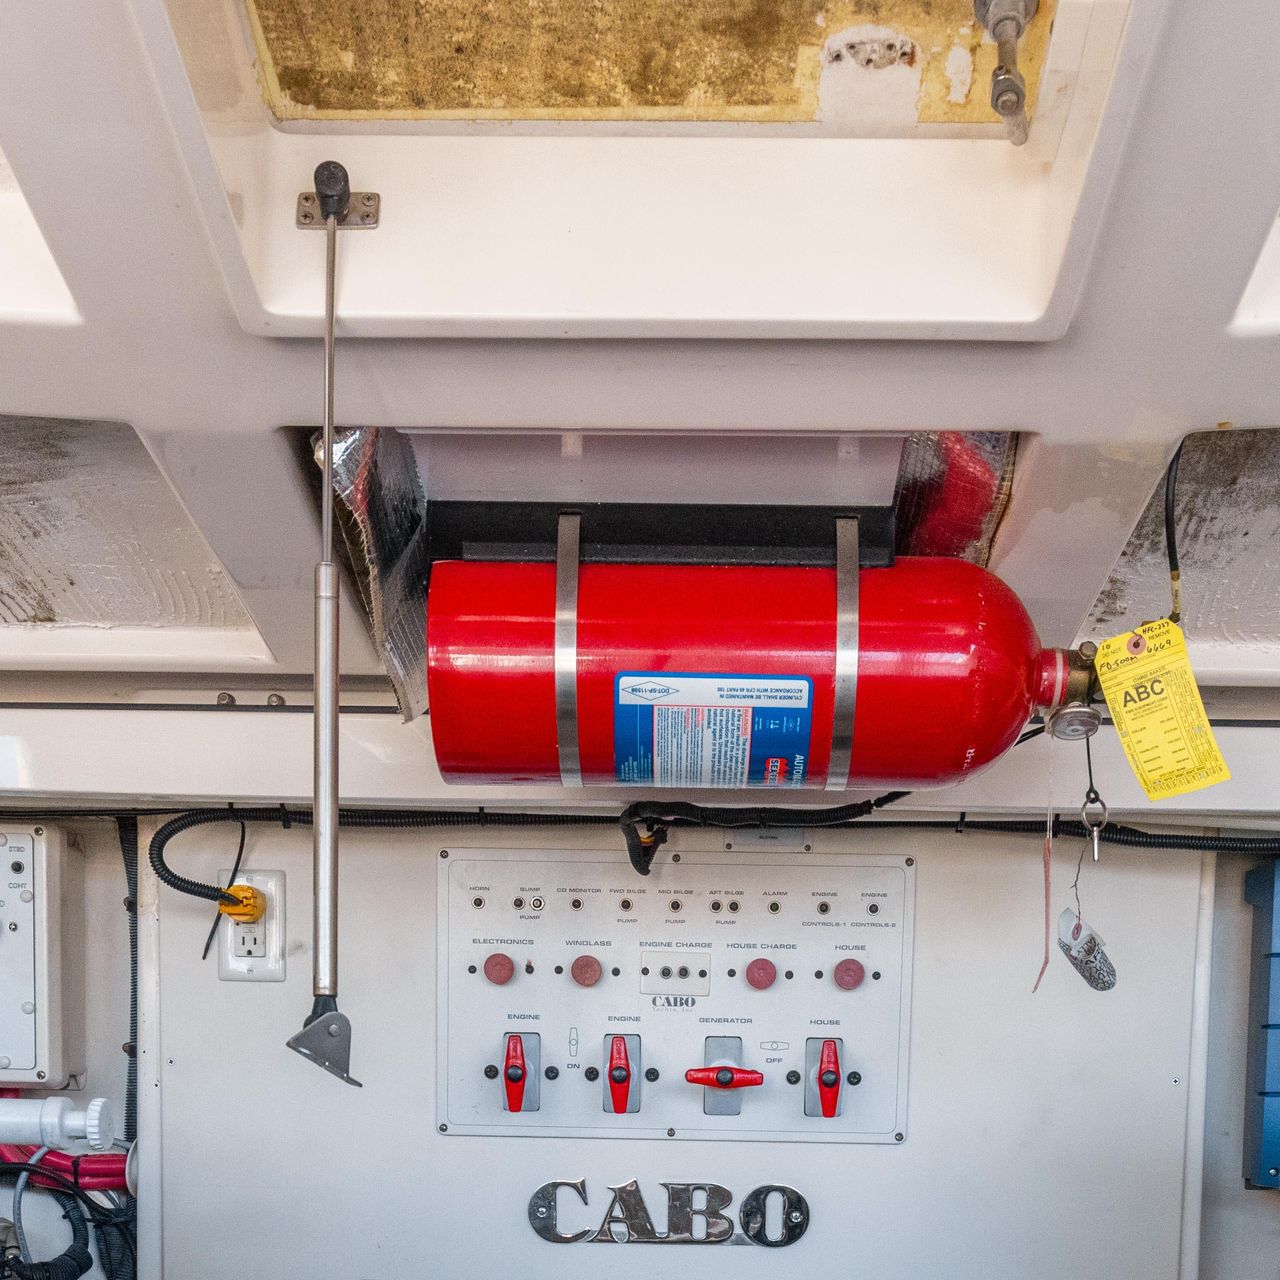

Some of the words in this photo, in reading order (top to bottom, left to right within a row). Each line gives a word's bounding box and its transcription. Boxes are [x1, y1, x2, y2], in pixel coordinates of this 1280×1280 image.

[1123, 679, 1165, 708] ABC
[651, 996, 696, 1007] CABO
[528, 1177, 810, 1248] CABO
